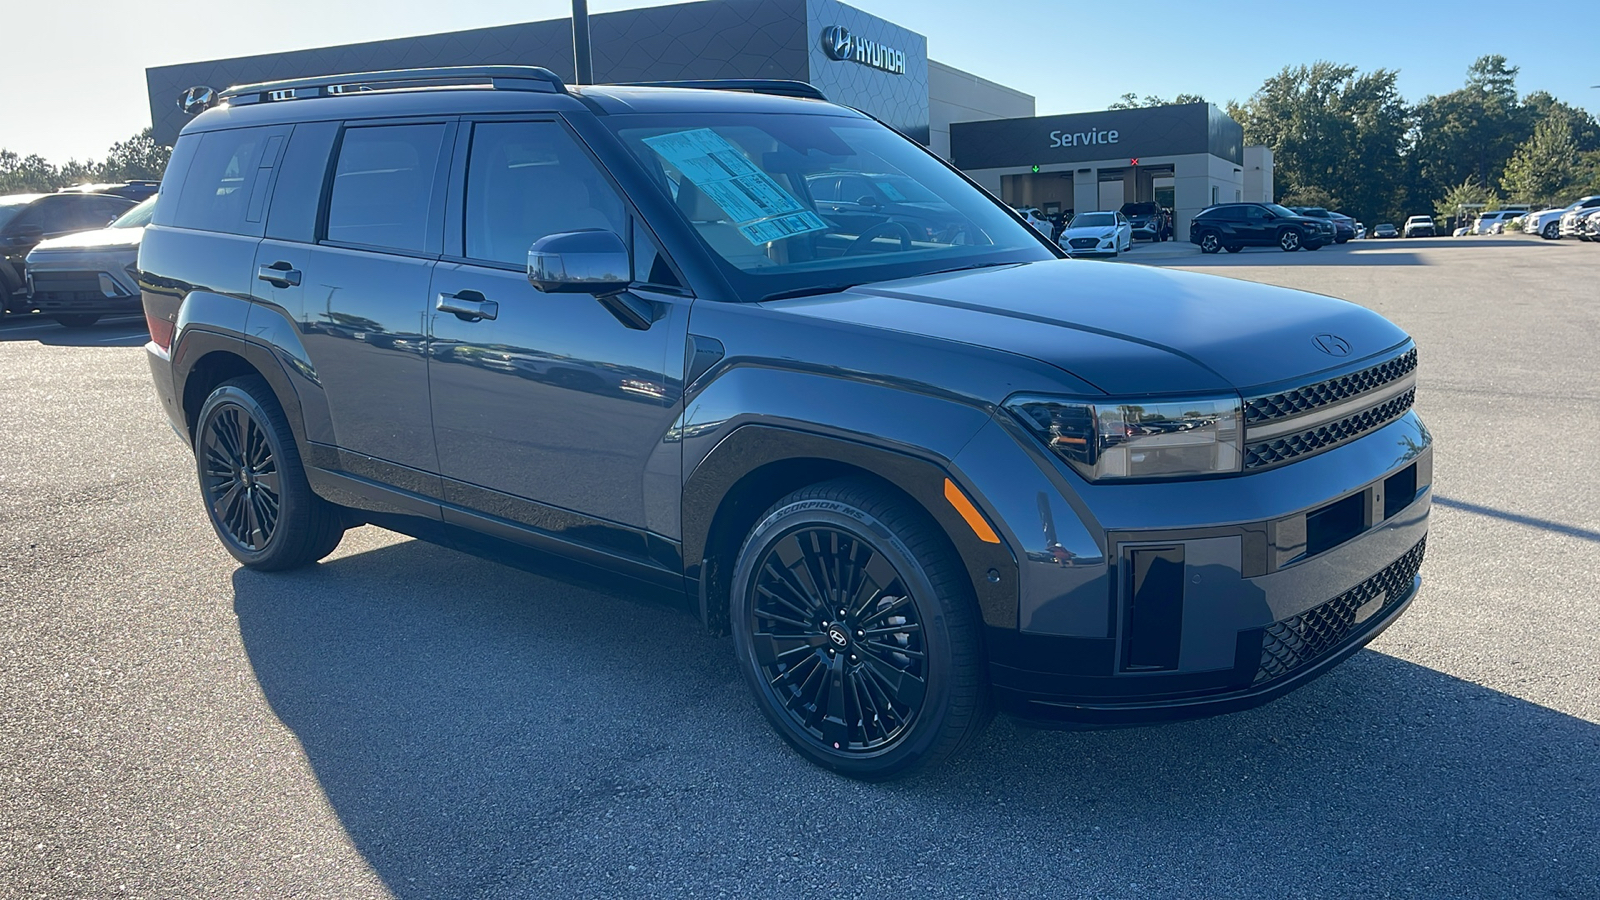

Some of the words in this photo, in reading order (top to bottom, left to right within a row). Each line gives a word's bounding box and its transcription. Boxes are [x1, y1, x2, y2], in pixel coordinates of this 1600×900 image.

[856, 36, 906, 74] HYUNDAI
[1050, 127, 1119, 148] Service
[776, 501, 839, 519] SCORPION
[842, 507, 865, 519] MS
